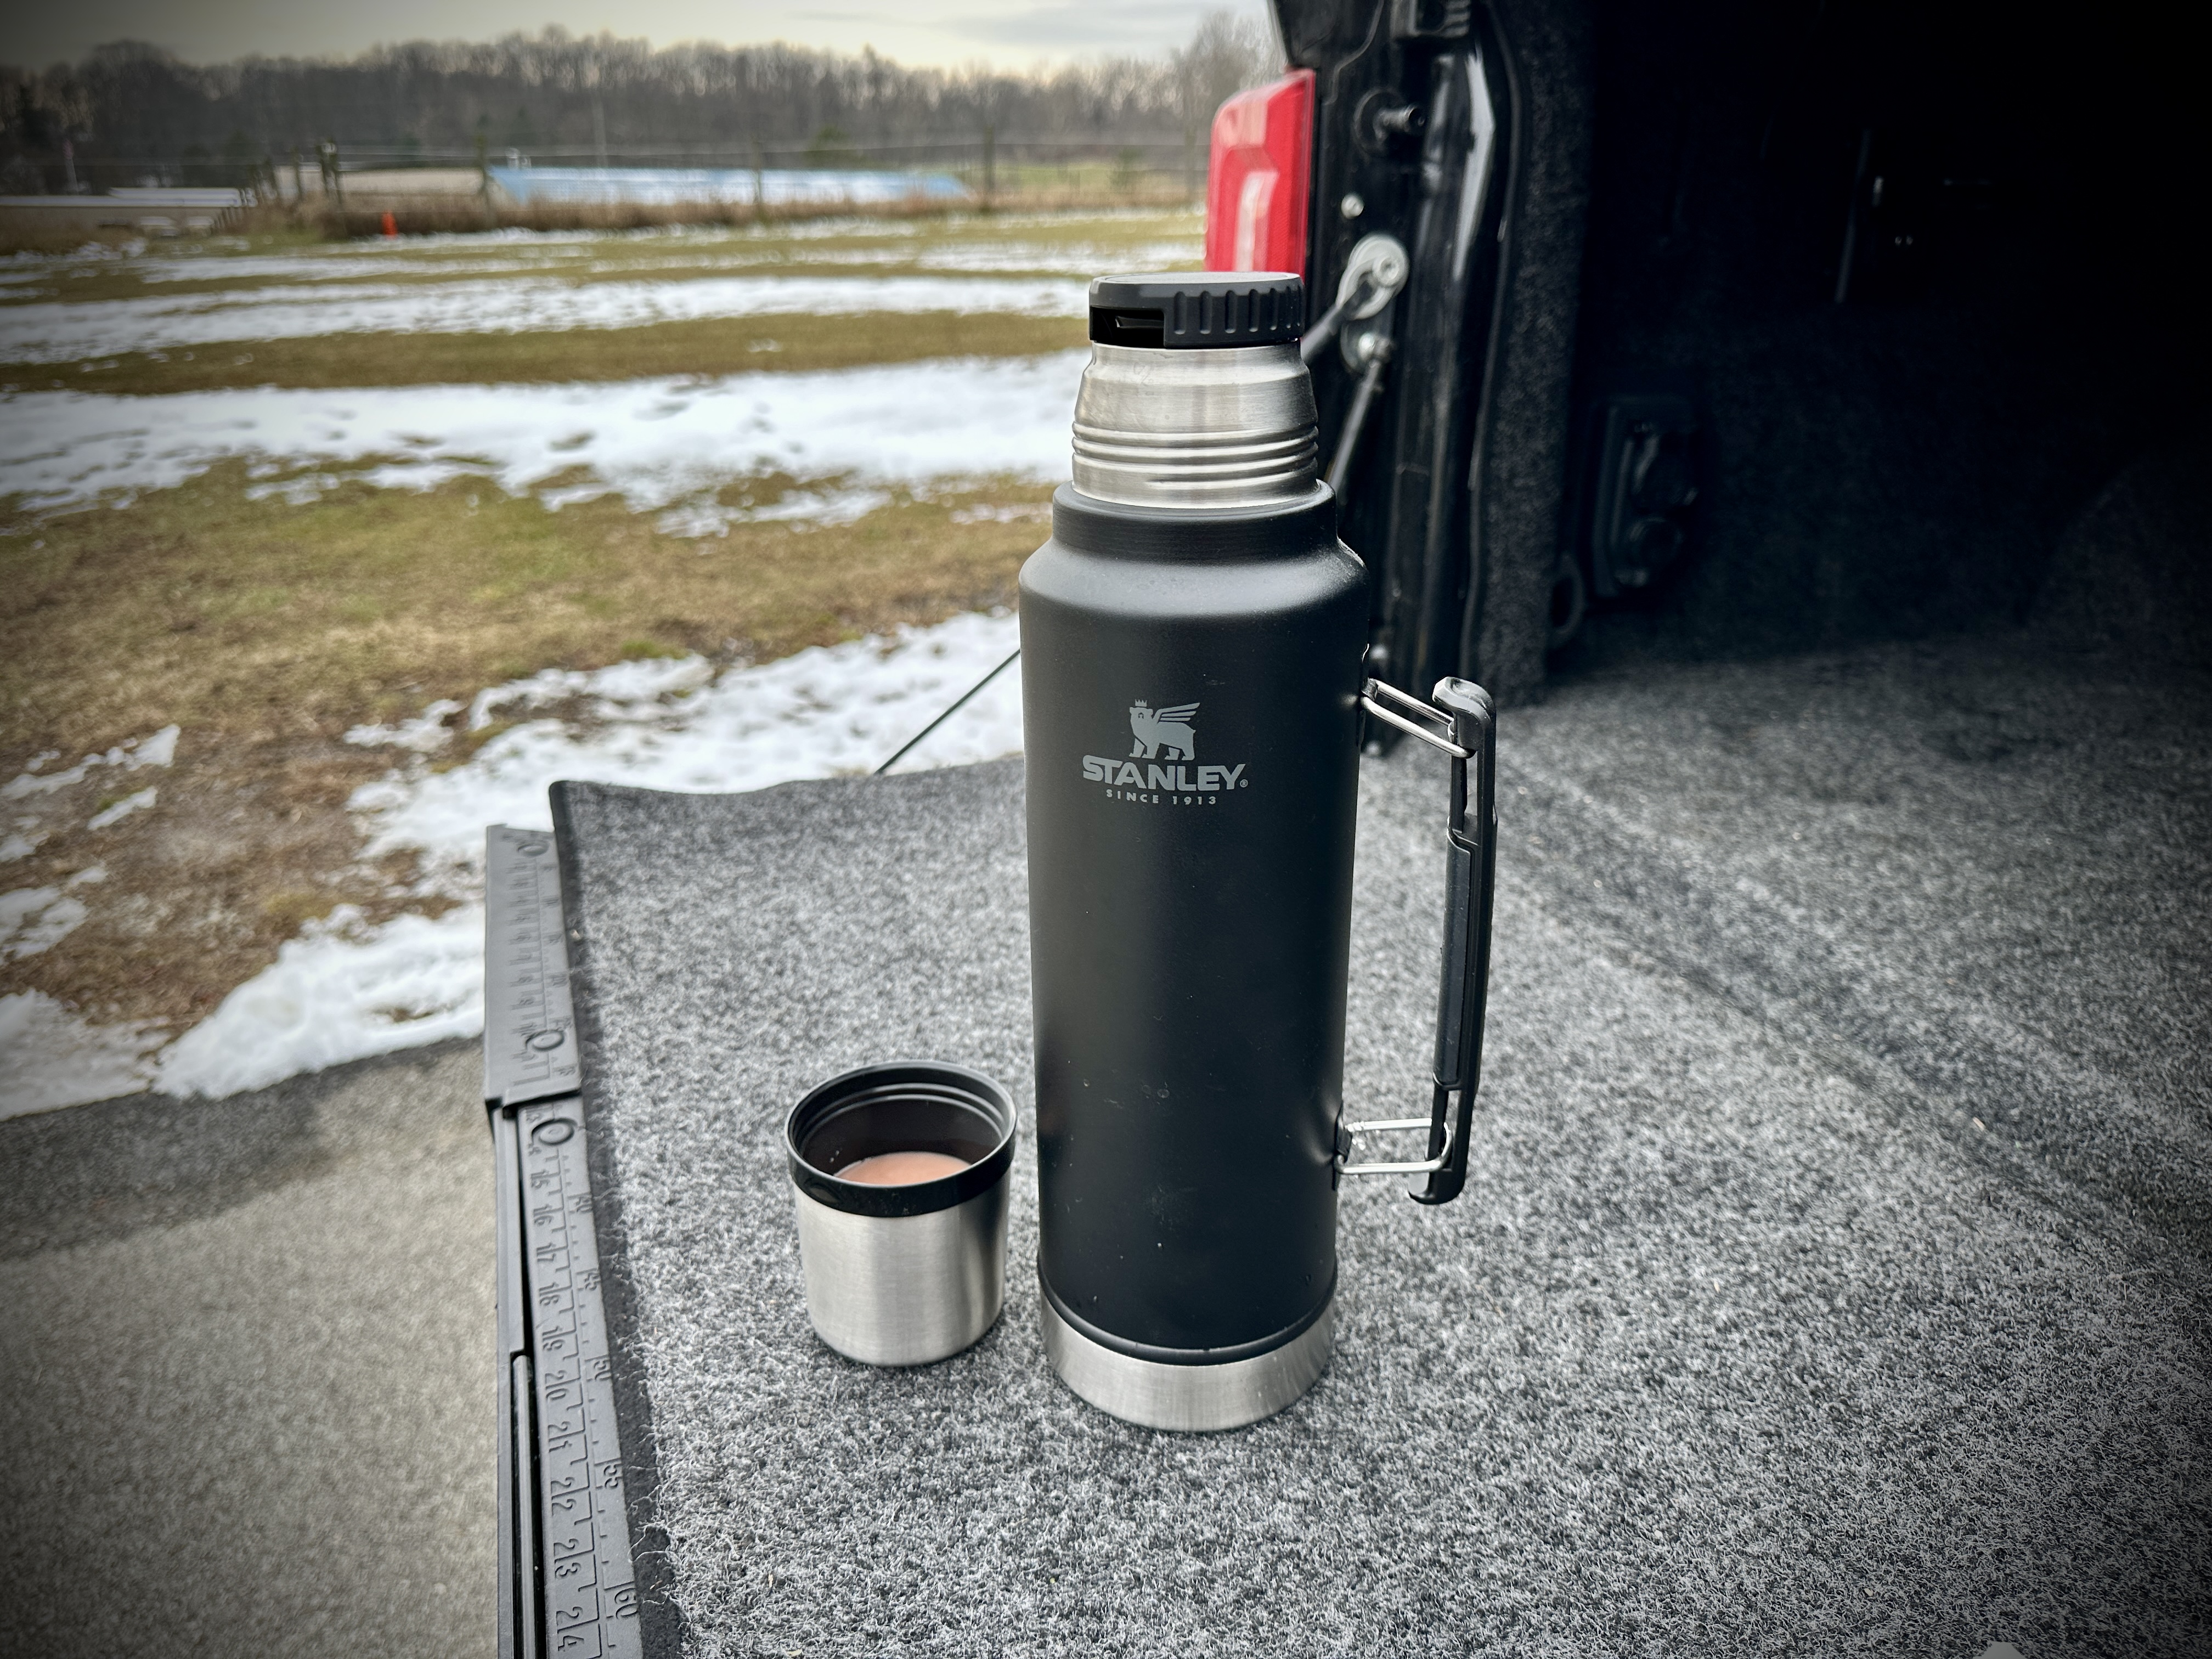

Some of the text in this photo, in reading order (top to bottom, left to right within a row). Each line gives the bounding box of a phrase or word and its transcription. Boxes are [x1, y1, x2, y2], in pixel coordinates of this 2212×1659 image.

[1106, 789, 1216, 805] SINCE 1913
[531, 1169, 550, 1189] 15
[533, 1204, 554, 1226] 16
[536, 1242, 556, 1262] 17
[584, 1272, 602, 1290] 45
[539, 1282, 560, 1306] 18
[542, 1325, 565, 1351] 19
[593, 1359, 612, 1381] 50
[545, 1370, 569, 1401] 20
[548, 1421, 572, 1453] 21
[603, 1464, 623, 1489] 55
[551, 1477, 577, 1516] 22
[554, 1538, 581, 1579] 23
[614, 1587, 638, 1619] 60
[556, 1606, 584, 1652] 24
